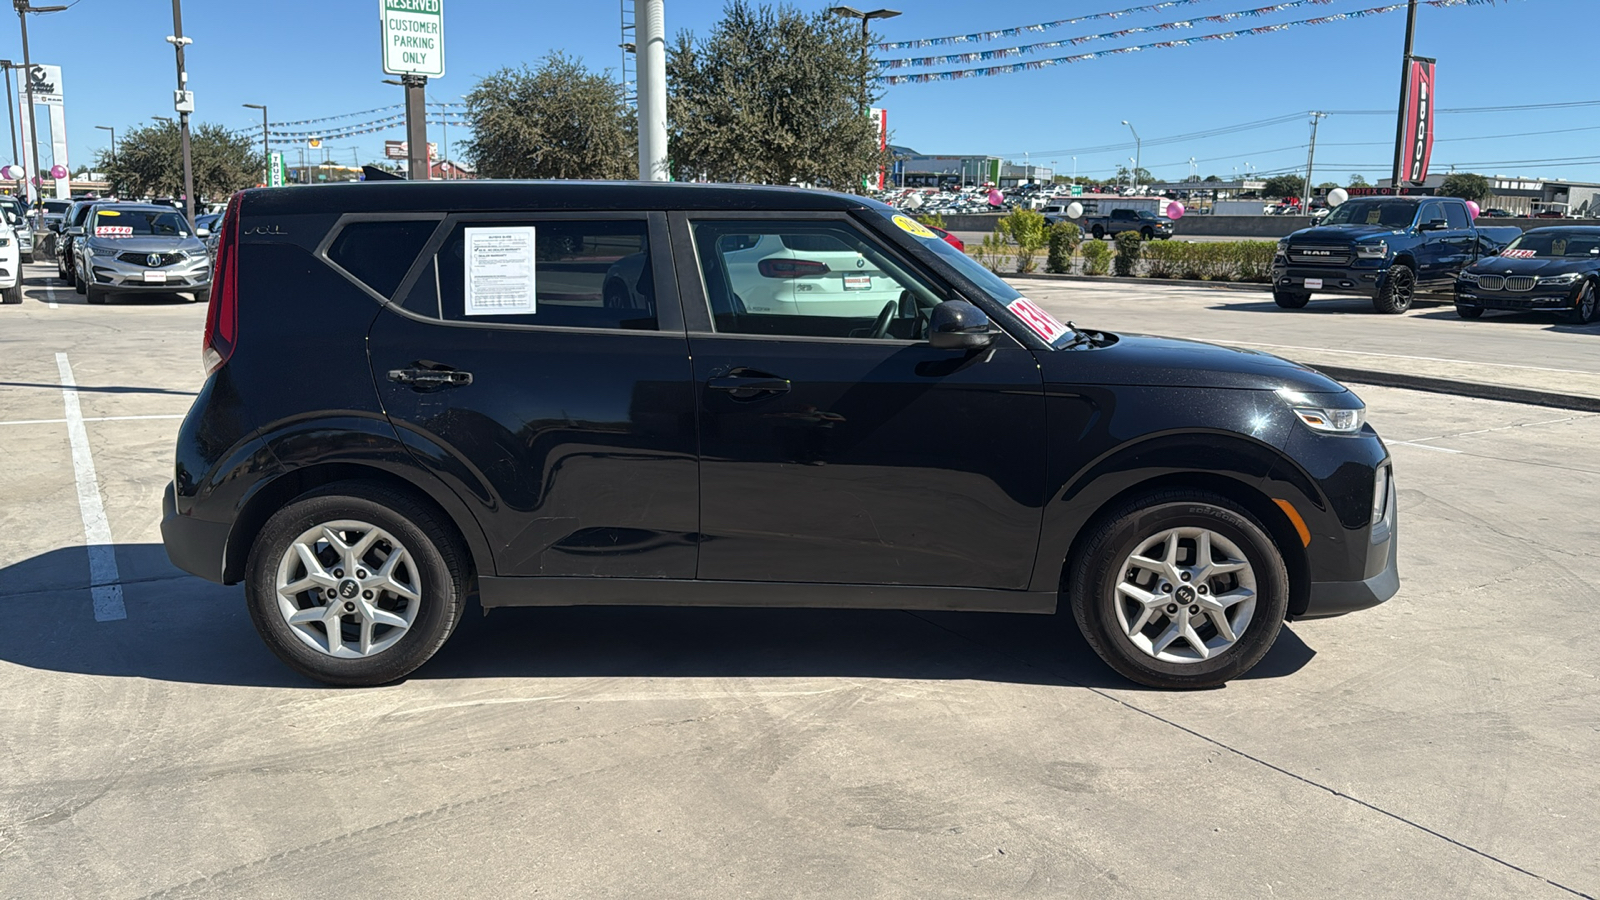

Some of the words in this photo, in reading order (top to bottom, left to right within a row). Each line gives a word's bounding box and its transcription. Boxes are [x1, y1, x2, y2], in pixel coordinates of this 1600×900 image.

[386, 0, 439, 12] RESERVED
[389, 18, 438, 34] CUSTOMER
[393, 35, 434, 49] PARKING
[402, 51, 427, 64] ONLY
[1411, 82, 1427, 180] DODGE
[342, 581, 355, 596] KIA
[1178, 588, 1192, 602] KIA
